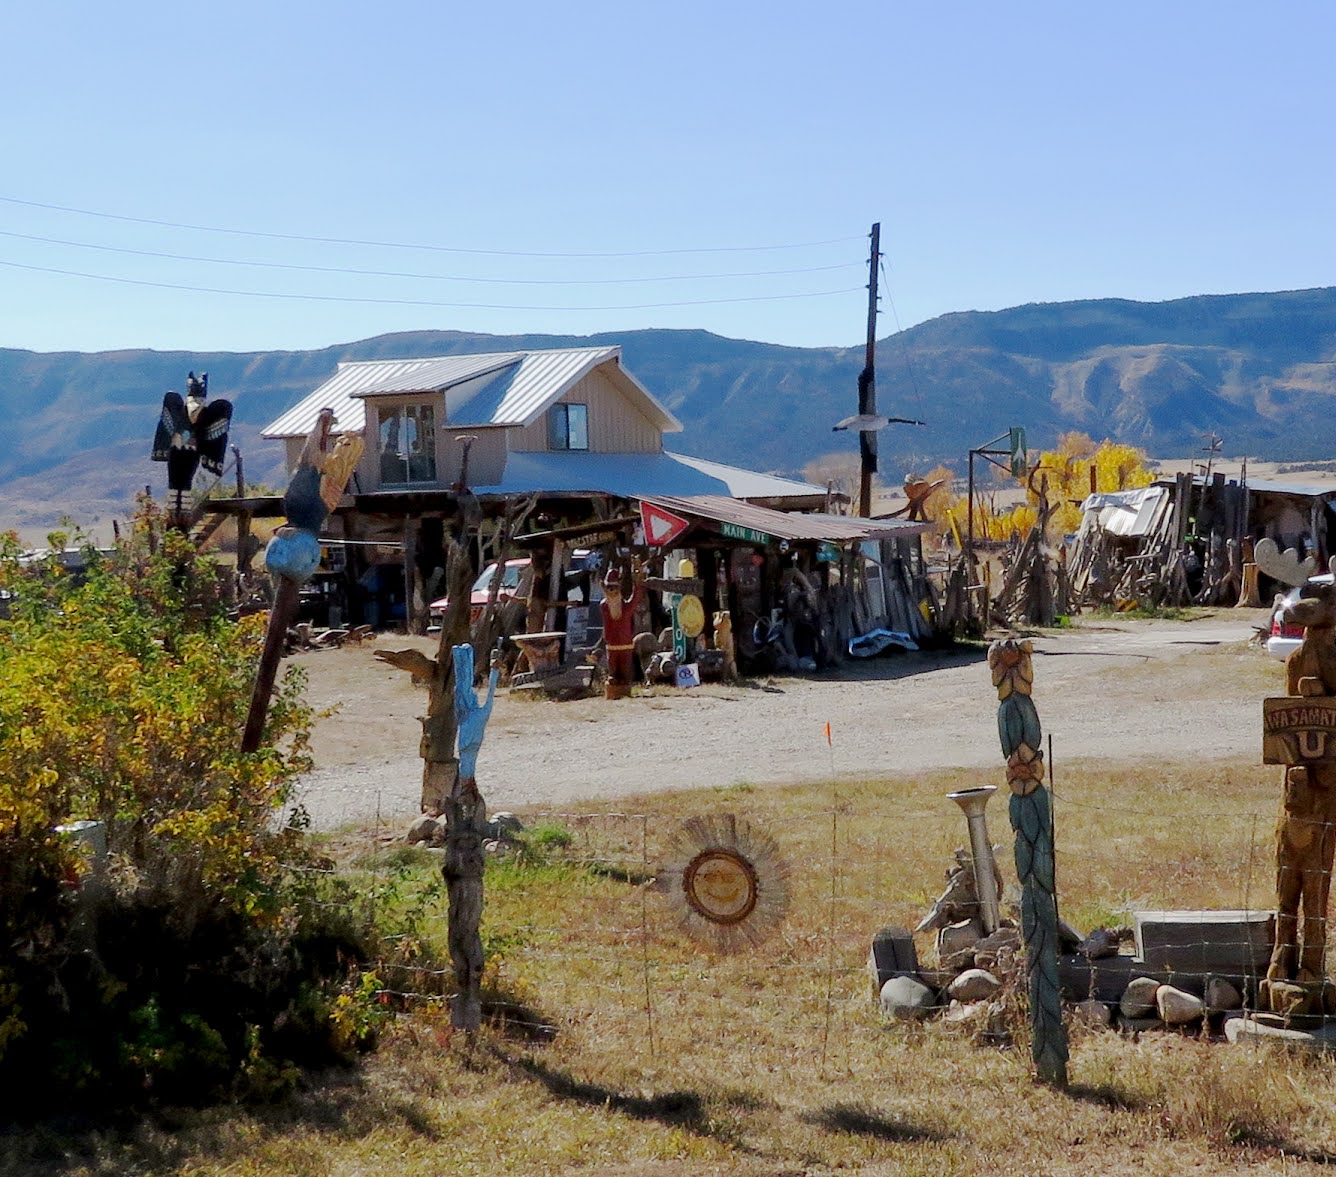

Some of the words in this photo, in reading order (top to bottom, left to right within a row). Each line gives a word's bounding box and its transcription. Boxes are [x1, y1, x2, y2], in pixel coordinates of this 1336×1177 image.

[723, 524, 746, 538] MAIN
[750, 531, 766, 543] AVE
[1296, 731, 1329, 758] U
